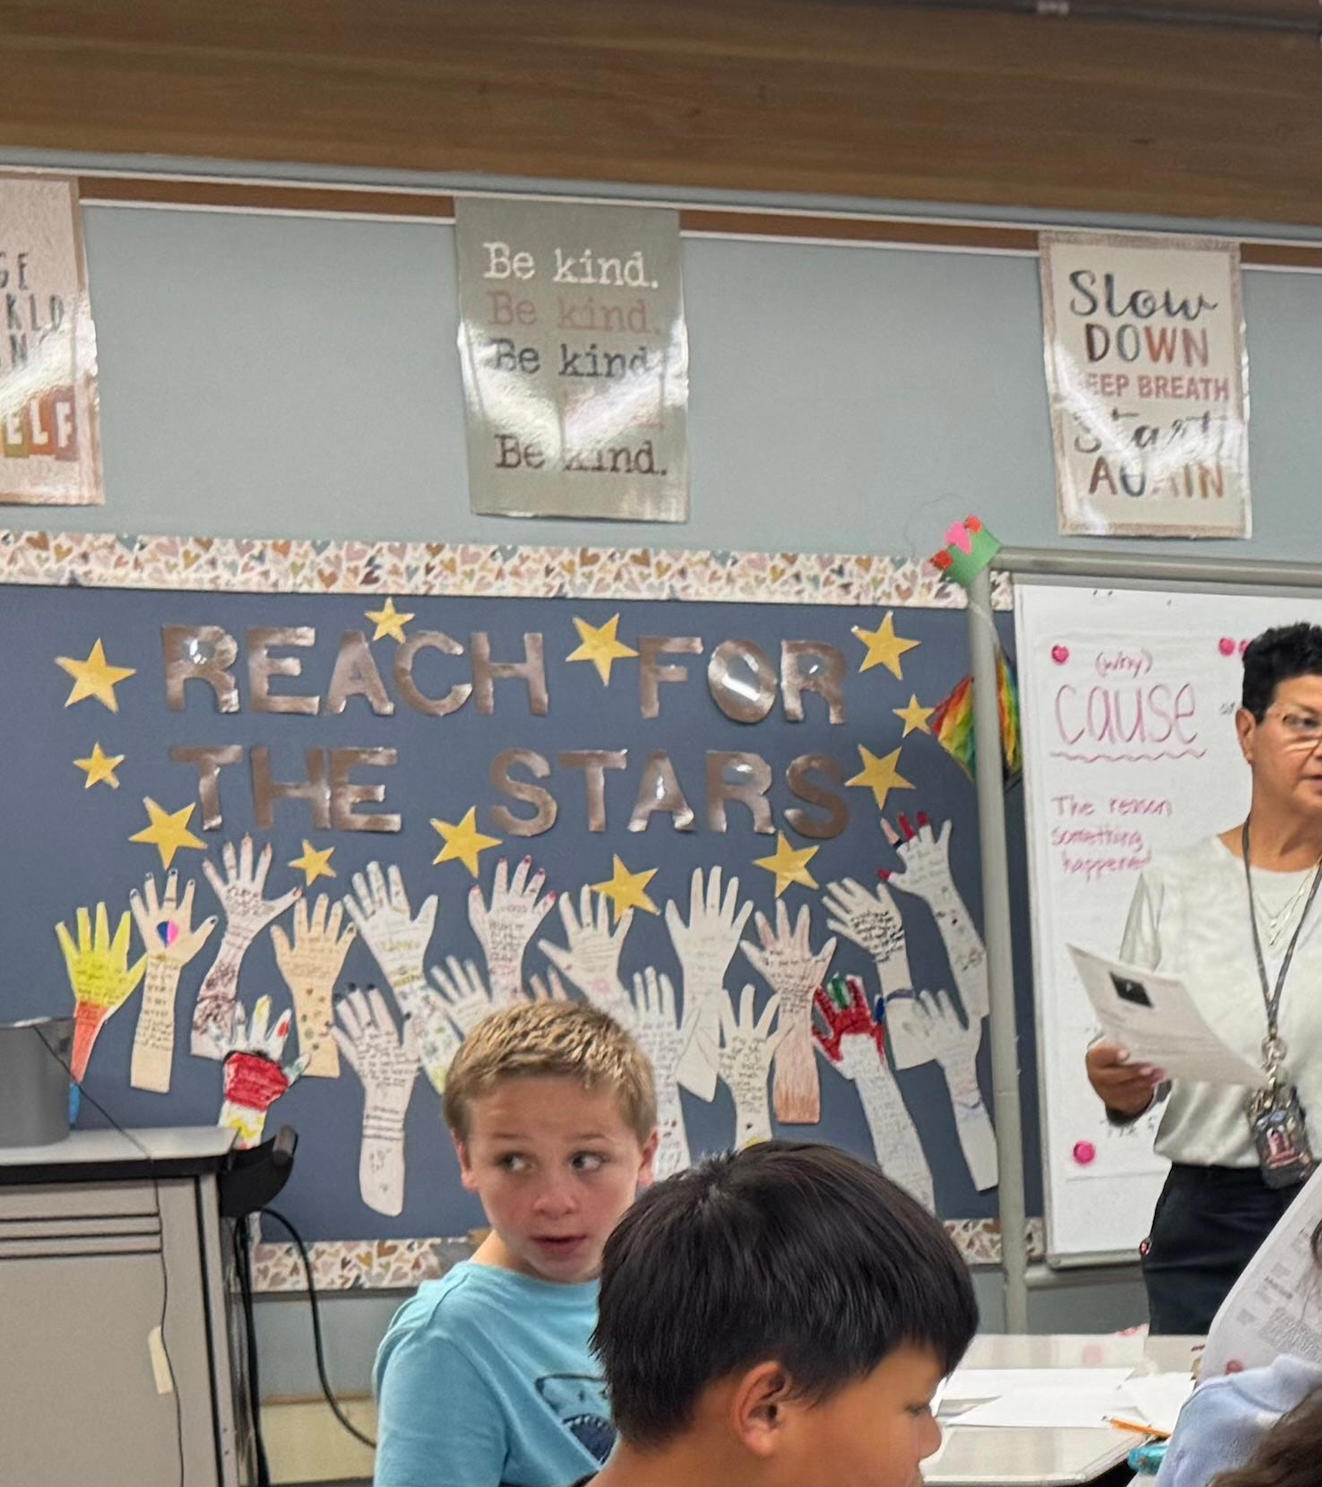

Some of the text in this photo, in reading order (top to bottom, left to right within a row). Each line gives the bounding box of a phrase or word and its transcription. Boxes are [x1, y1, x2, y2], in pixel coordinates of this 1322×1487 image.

[483, 242, 658, 288] Be kind.
[488, 291, 661, 336] Be kind.
[1069, 270, 1218, 321] Slow
[490, 339, 540, 373] Be
[1084, 323, 1209, 367] DOWN
[1084, 374, 1229, 399] EEP BREATH
[494, 434, 545, 468] Be
[162, 625, 846, 726] REACH FOR
[170, 745, 853, 840] THE STARS
[1050, 794, 1096, 817] The
